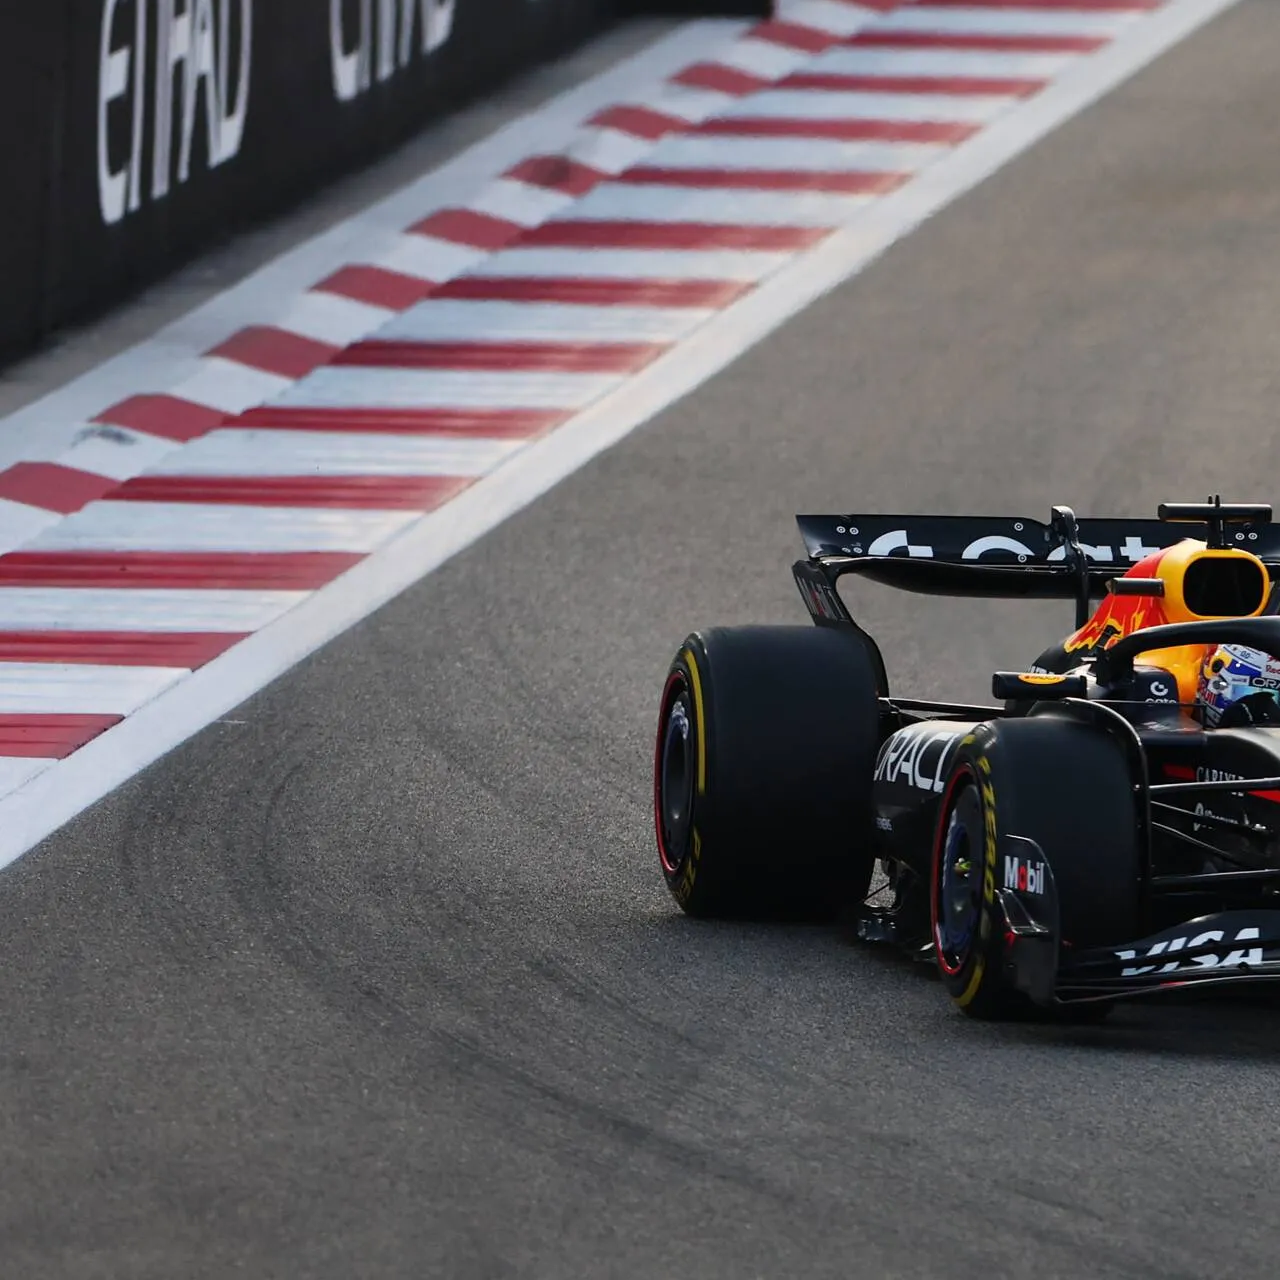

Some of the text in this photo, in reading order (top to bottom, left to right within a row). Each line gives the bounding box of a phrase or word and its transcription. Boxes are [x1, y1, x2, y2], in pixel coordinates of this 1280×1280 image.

[873, 731, 961, 794] ORACL
[1004, 855, 1045, 895] Mobil
[1114, 927, 1263, 976] VISA
